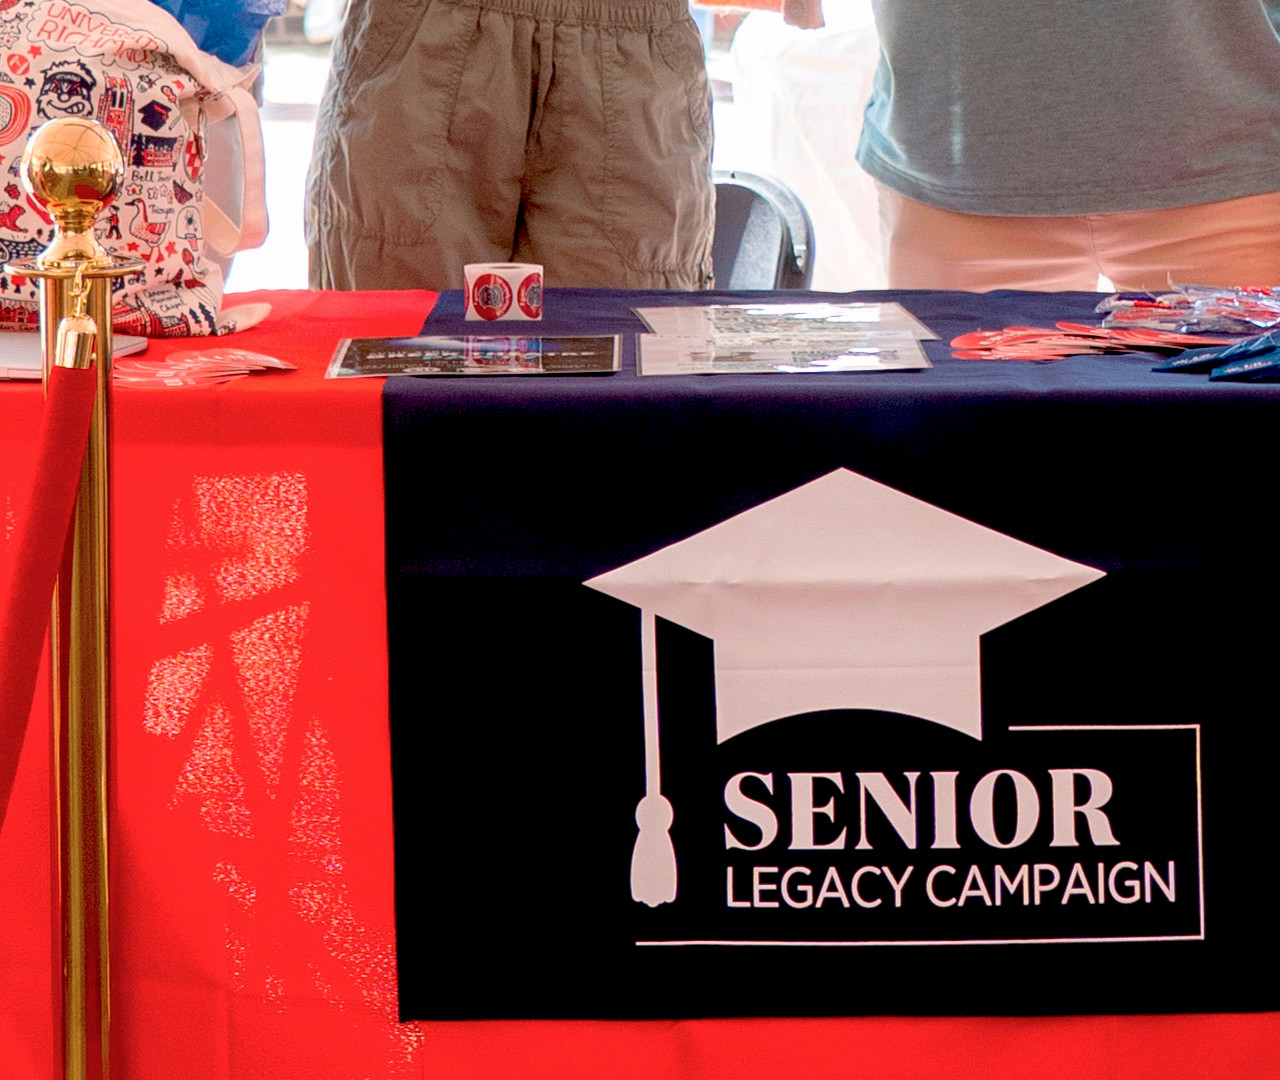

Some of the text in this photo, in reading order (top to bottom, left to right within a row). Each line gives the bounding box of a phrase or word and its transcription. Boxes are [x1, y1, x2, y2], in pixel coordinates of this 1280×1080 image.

[131, 170, 153, 182] Bell
[723, 768, 1121, 851] SENIOR
[726, 860, 1176, 909] LEGACY CAMPAIGN
